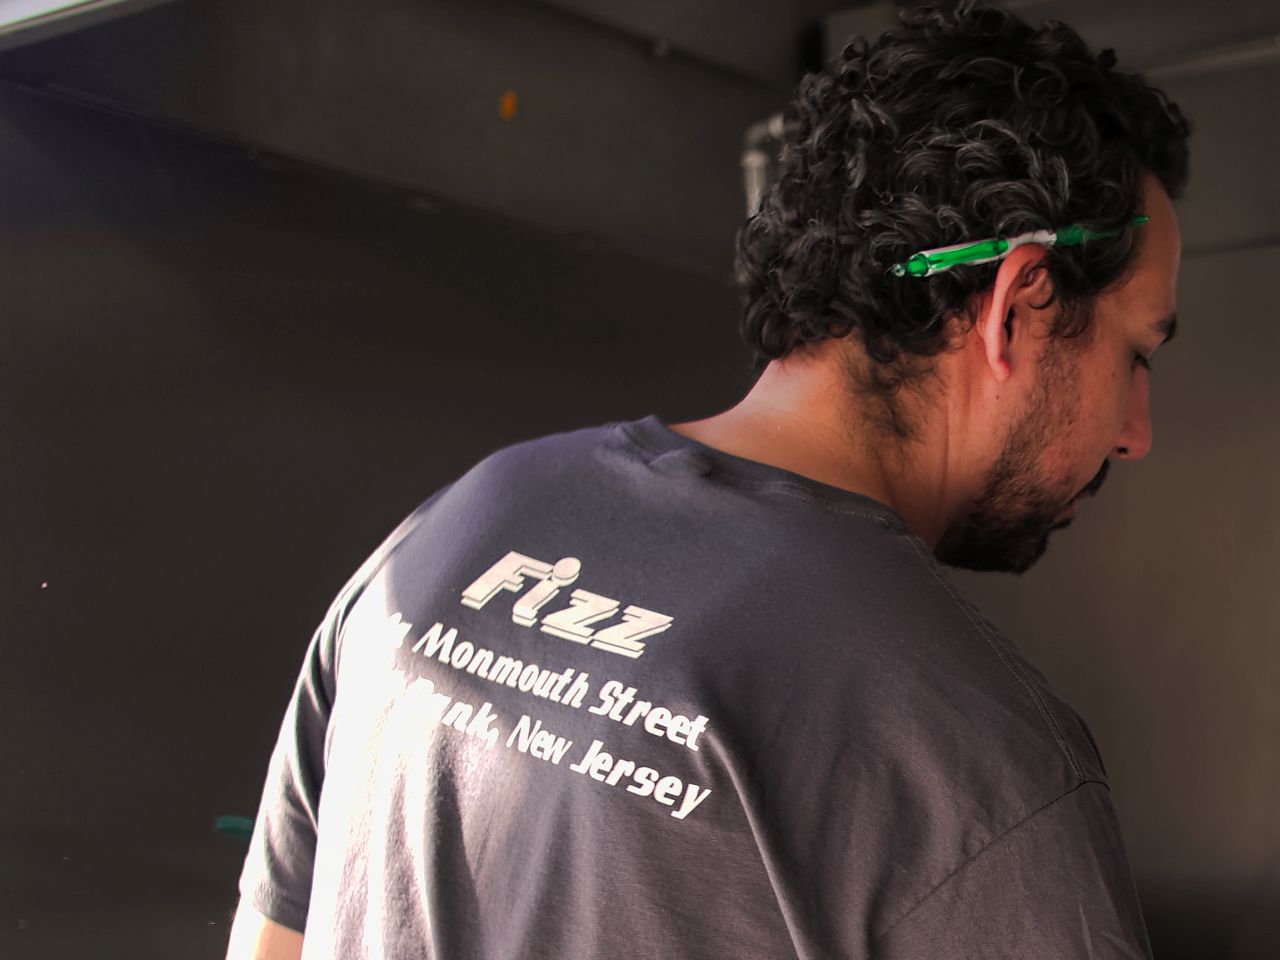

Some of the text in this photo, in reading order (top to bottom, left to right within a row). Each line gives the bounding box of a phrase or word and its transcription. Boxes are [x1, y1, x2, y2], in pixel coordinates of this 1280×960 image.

[461, 551, 674, 659] Fizz
[412, 623, 589, 708] Monmouth
[588, 681, 709, 752] Street
[506, 715, 573, 765] New
[570, 740, 711, 820] Jersey
